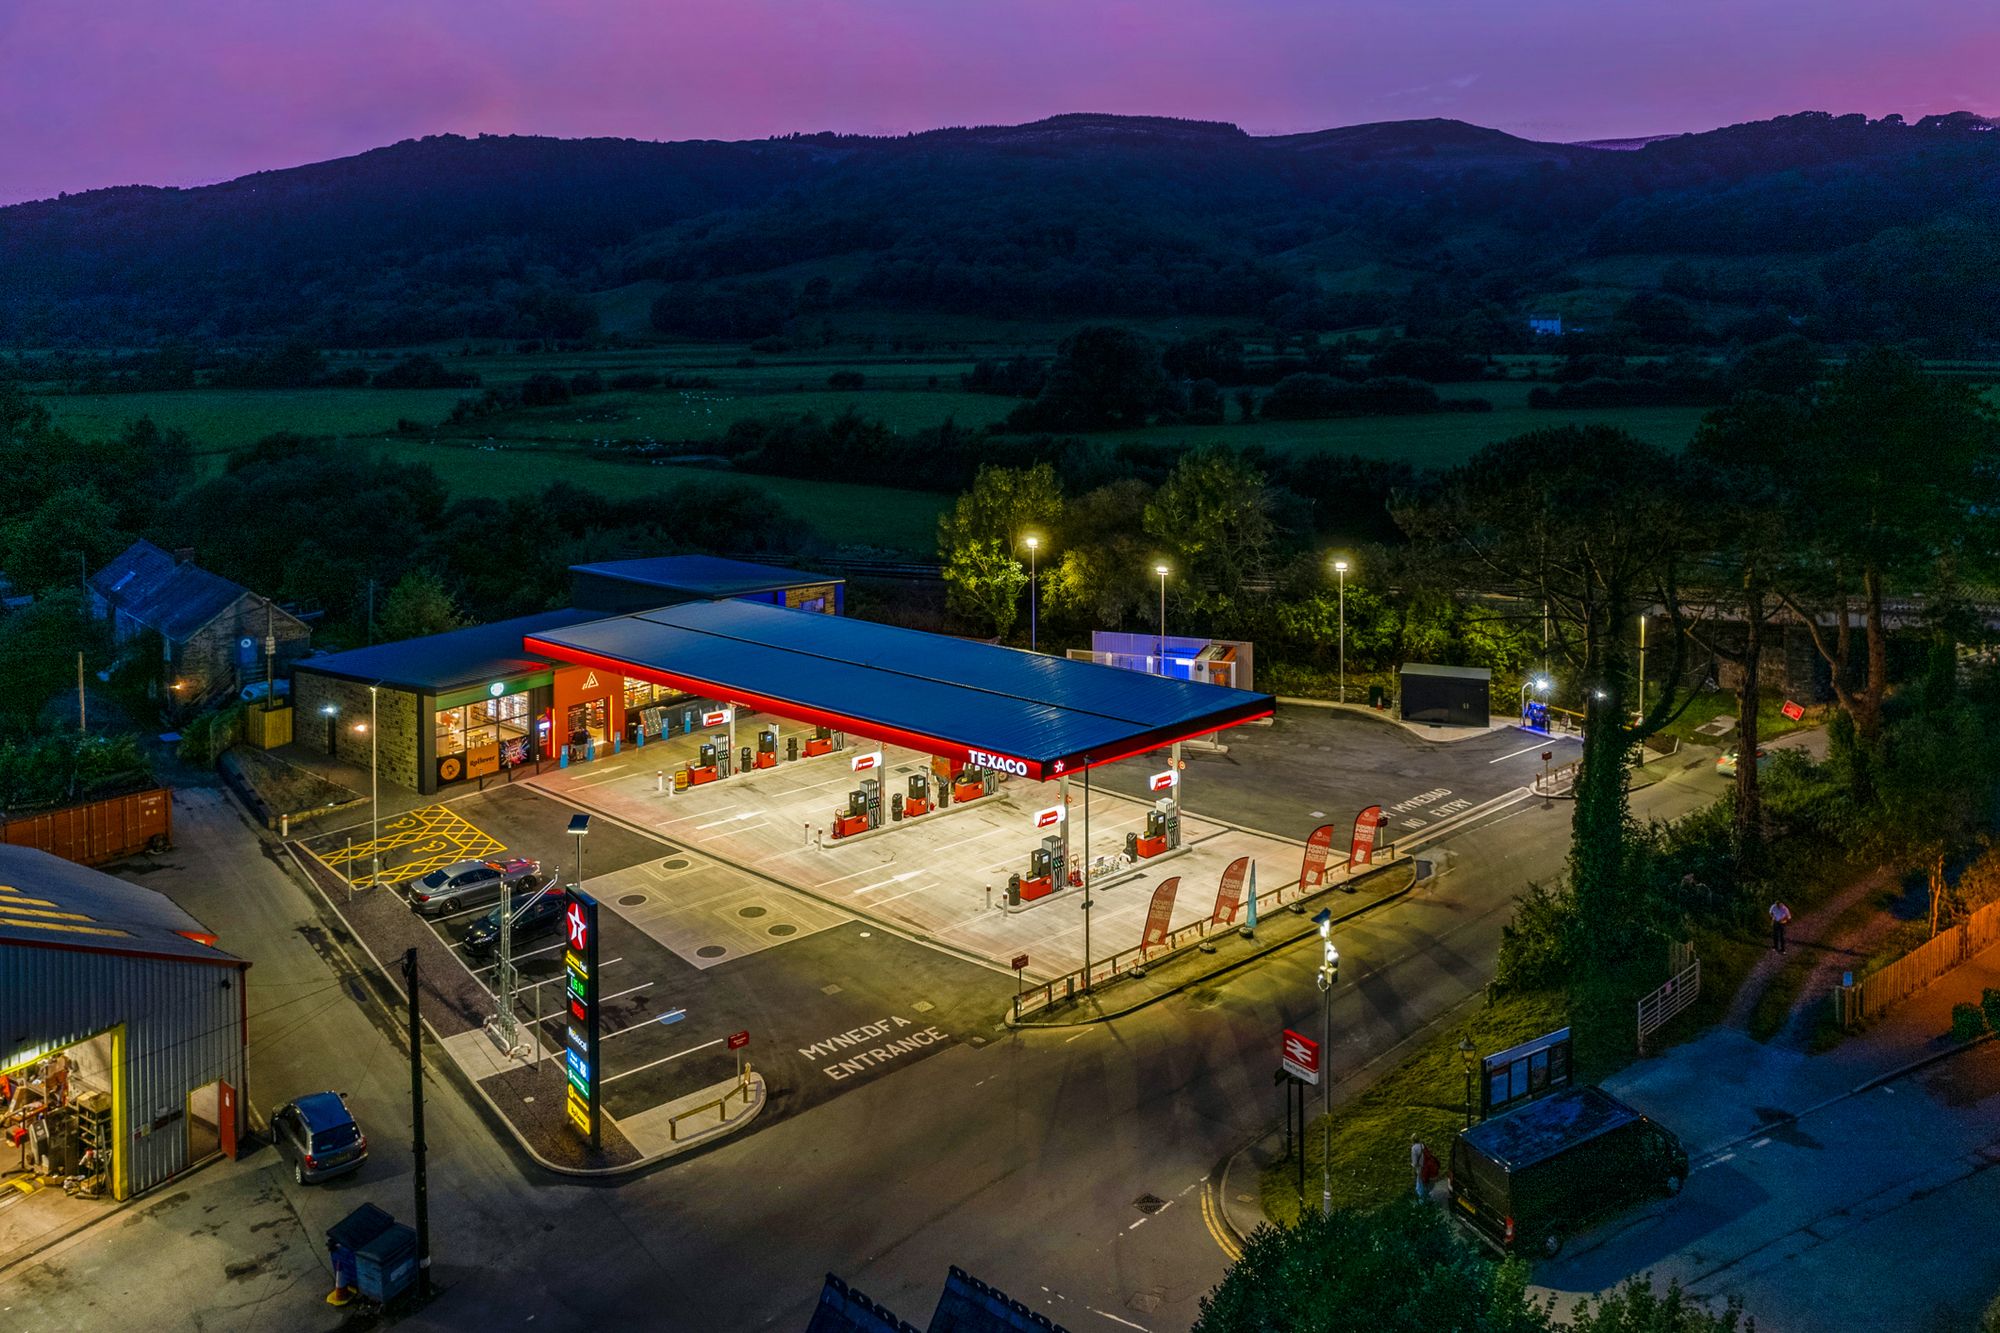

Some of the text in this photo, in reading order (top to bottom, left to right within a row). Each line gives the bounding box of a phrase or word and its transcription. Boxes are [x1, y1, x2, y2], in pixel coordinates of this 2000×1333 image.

[968, 750, 1027, 776] TEXACO
[1391, 788, 1453, 813] MYNEDIAD
[1401, 798, 1473, 829] NO ENTRY
[798, 1016, 911, 1060] MYNEDFA
[823, 1026, 949, 1080] ENTRANCE
